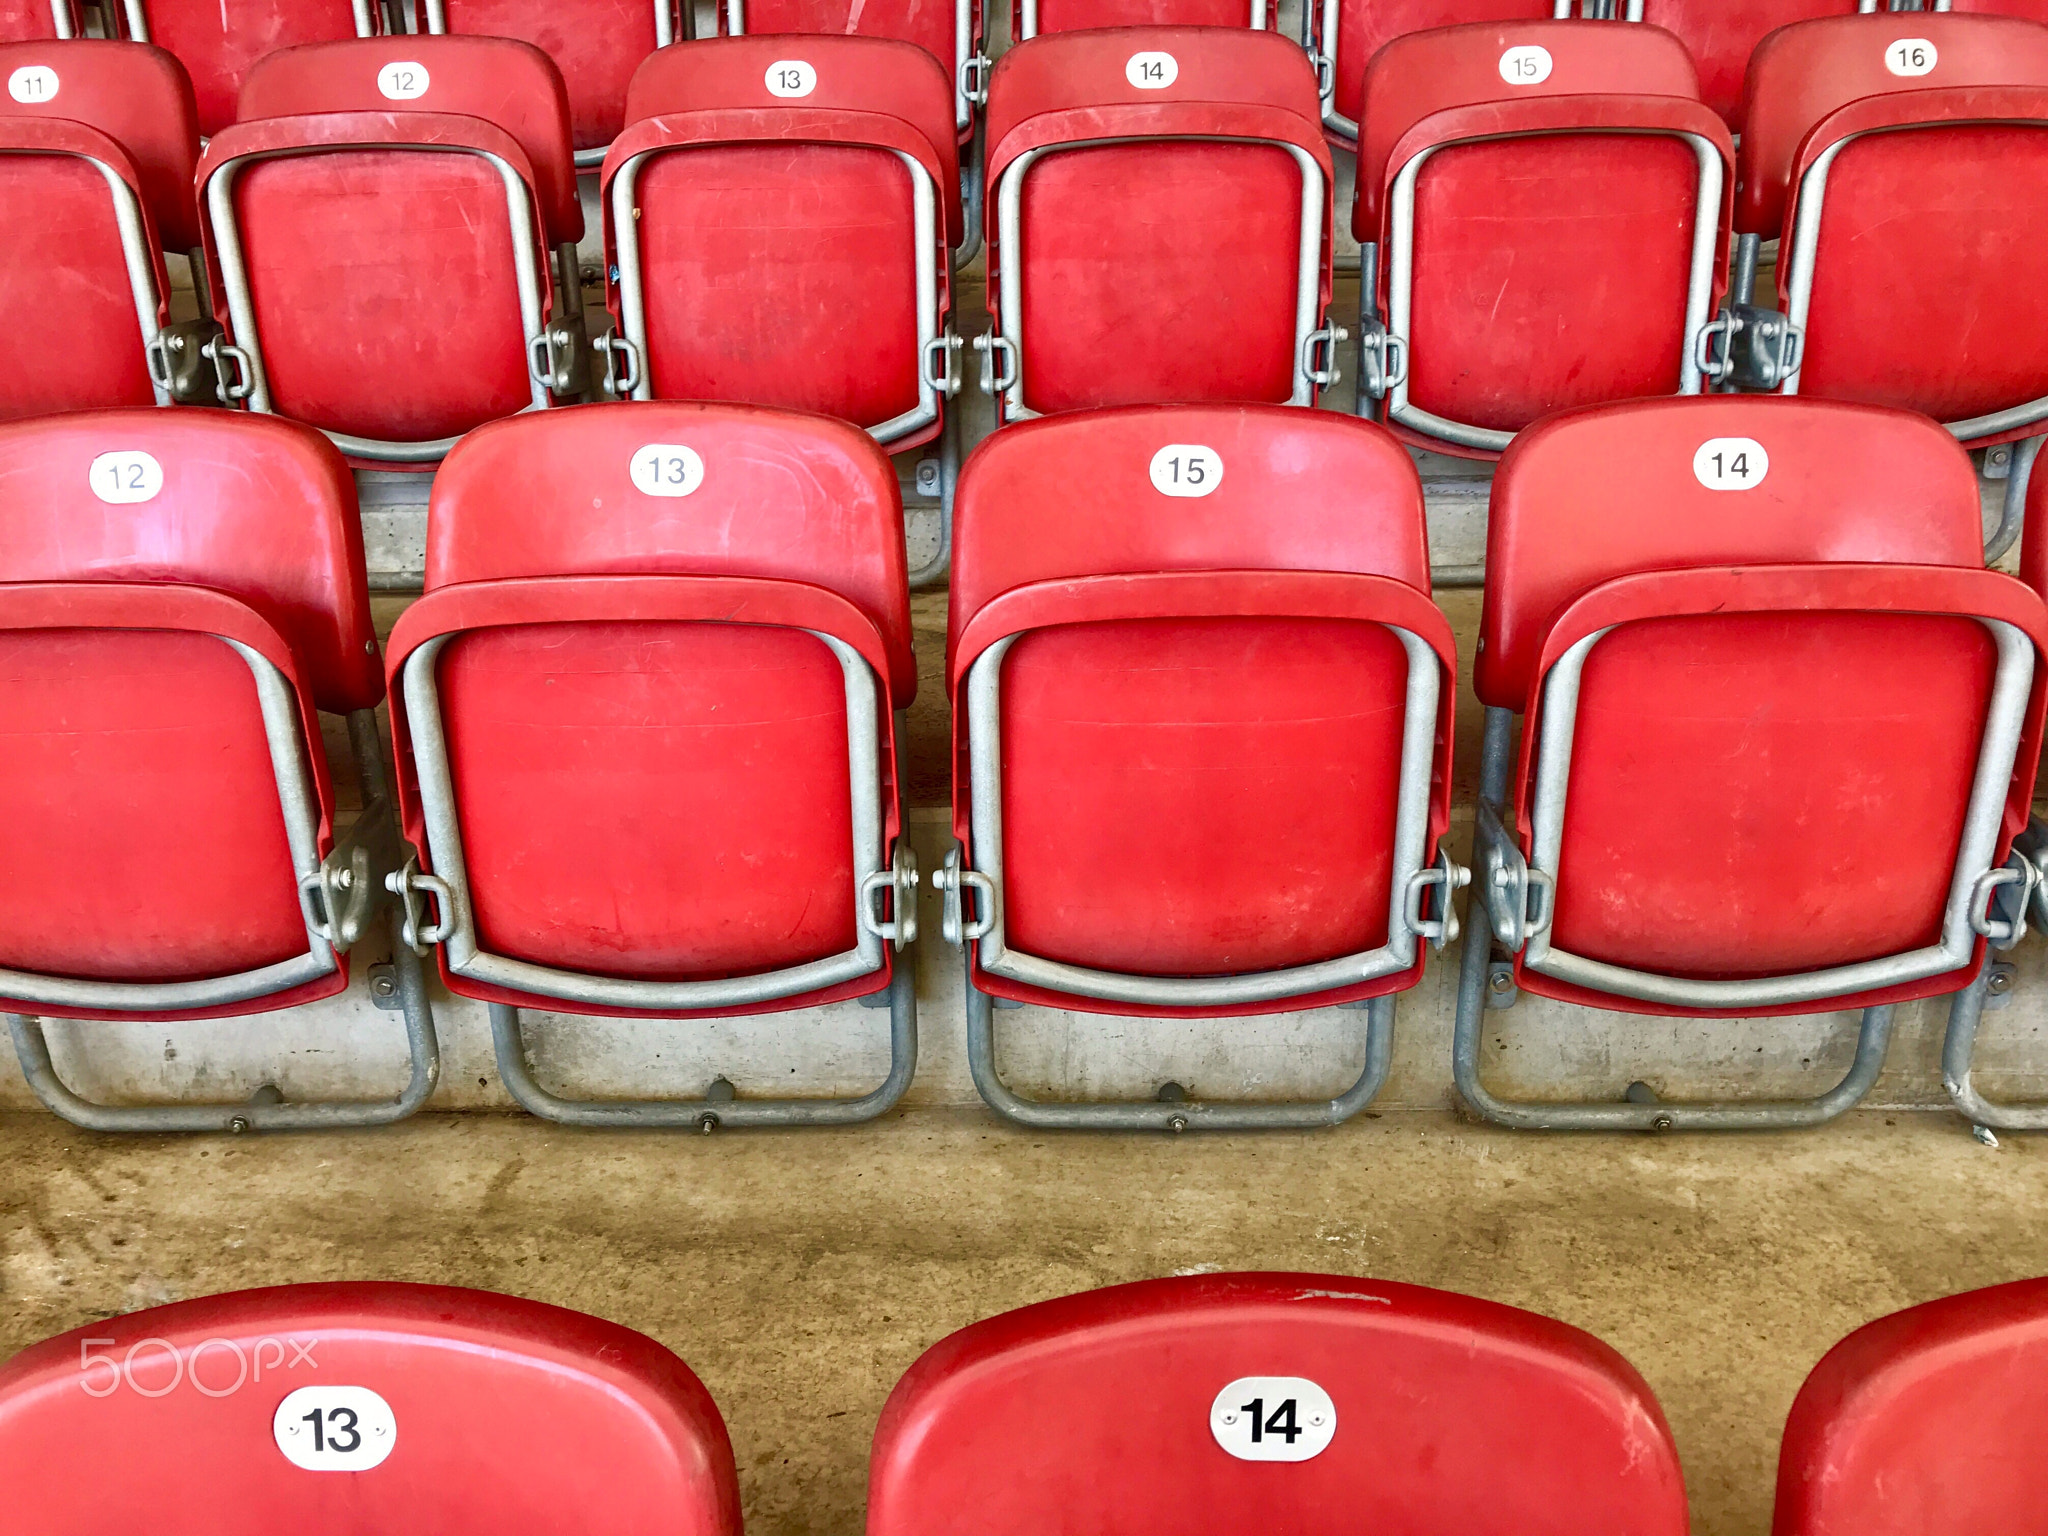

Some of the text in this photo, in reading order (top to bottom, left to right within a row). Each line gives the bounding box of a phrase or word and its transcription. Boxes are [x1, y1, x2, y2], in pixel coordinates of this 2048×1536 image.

[1514, 57, 1537, 76] 15
[1898, 48, 1925, 67] 16
[392, 72, 415, 90] 12
[778, 70, 802, 89] 13
[1140, 62, 1164, 80] 14
[24, 77, 43, 95] 11
[649, 457, 686, 484] 13
[1168, 457, 1205, 484] 15
[1711, 452, 1750, 478] 14
[109, 464, 145, 489] 12
[301, 1407, 362, 1453] 13
[1240, 1397, 1303, 1444] 14
